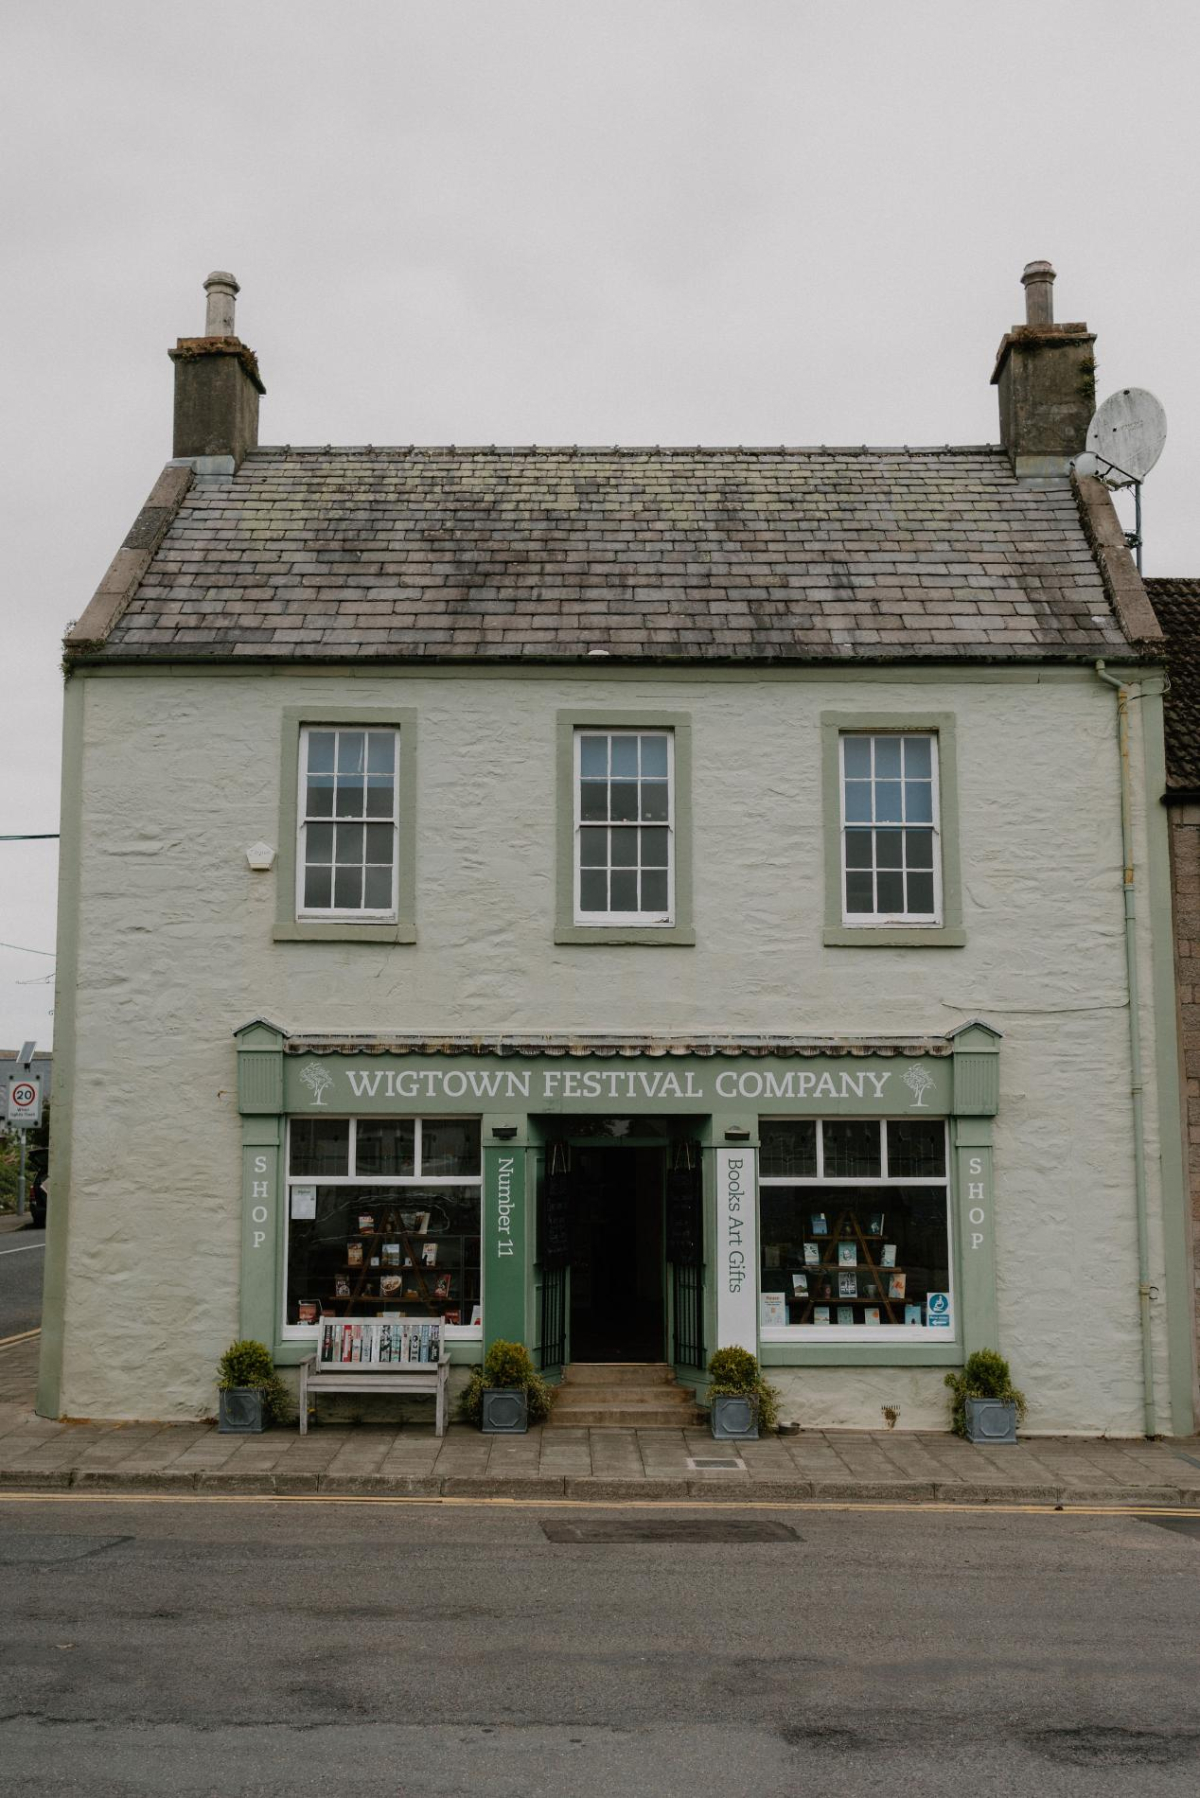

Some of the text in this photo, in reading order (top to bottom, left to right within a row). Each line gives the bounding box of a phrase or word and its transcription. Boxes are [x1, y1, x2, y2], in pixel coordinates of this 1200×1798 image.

[16, 1090, 32, 1100] 20
[346, 1070, 891, 1098] WIGTOWN FESTIVAL COMPANY
[252, 1155, 268, 1249] SHOP
[498, 1157, 514, 1258] Number 11
[727, 1157, 746, 1294] Books Art Gifts
[968, 1157, 985, 1250] SHOP
